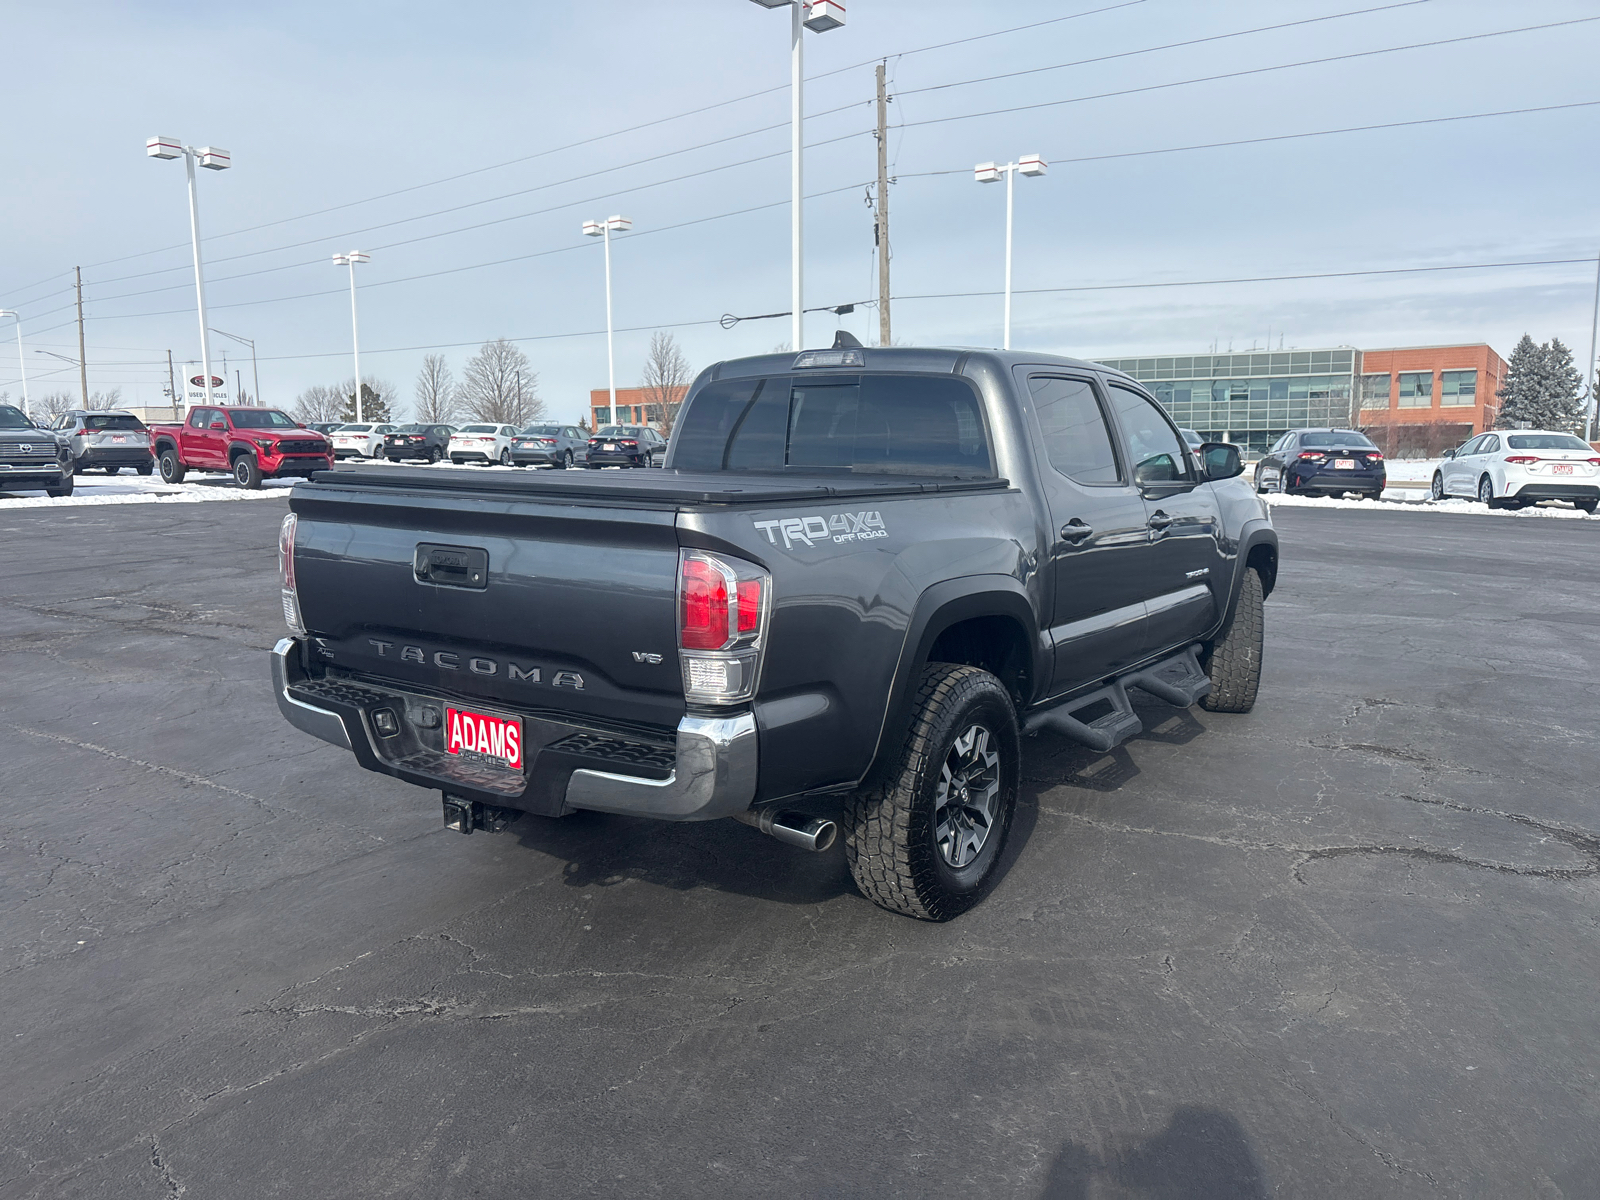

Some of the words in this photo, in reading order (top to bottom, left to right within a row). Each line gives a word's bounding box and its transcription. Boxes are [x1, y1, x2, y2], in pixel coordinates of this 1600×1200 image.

[1553, 465, 1573, 474] ADAMS
[753, 516, 829, 549] TRD
[833, 531, 856, 543] OFF
[858, 529, 888, 541] ROAD
[368, 638, 586, 691] TACOMA
[631, 651, 664, 665] V6
[450, 713, 520, 764] ADAMS
